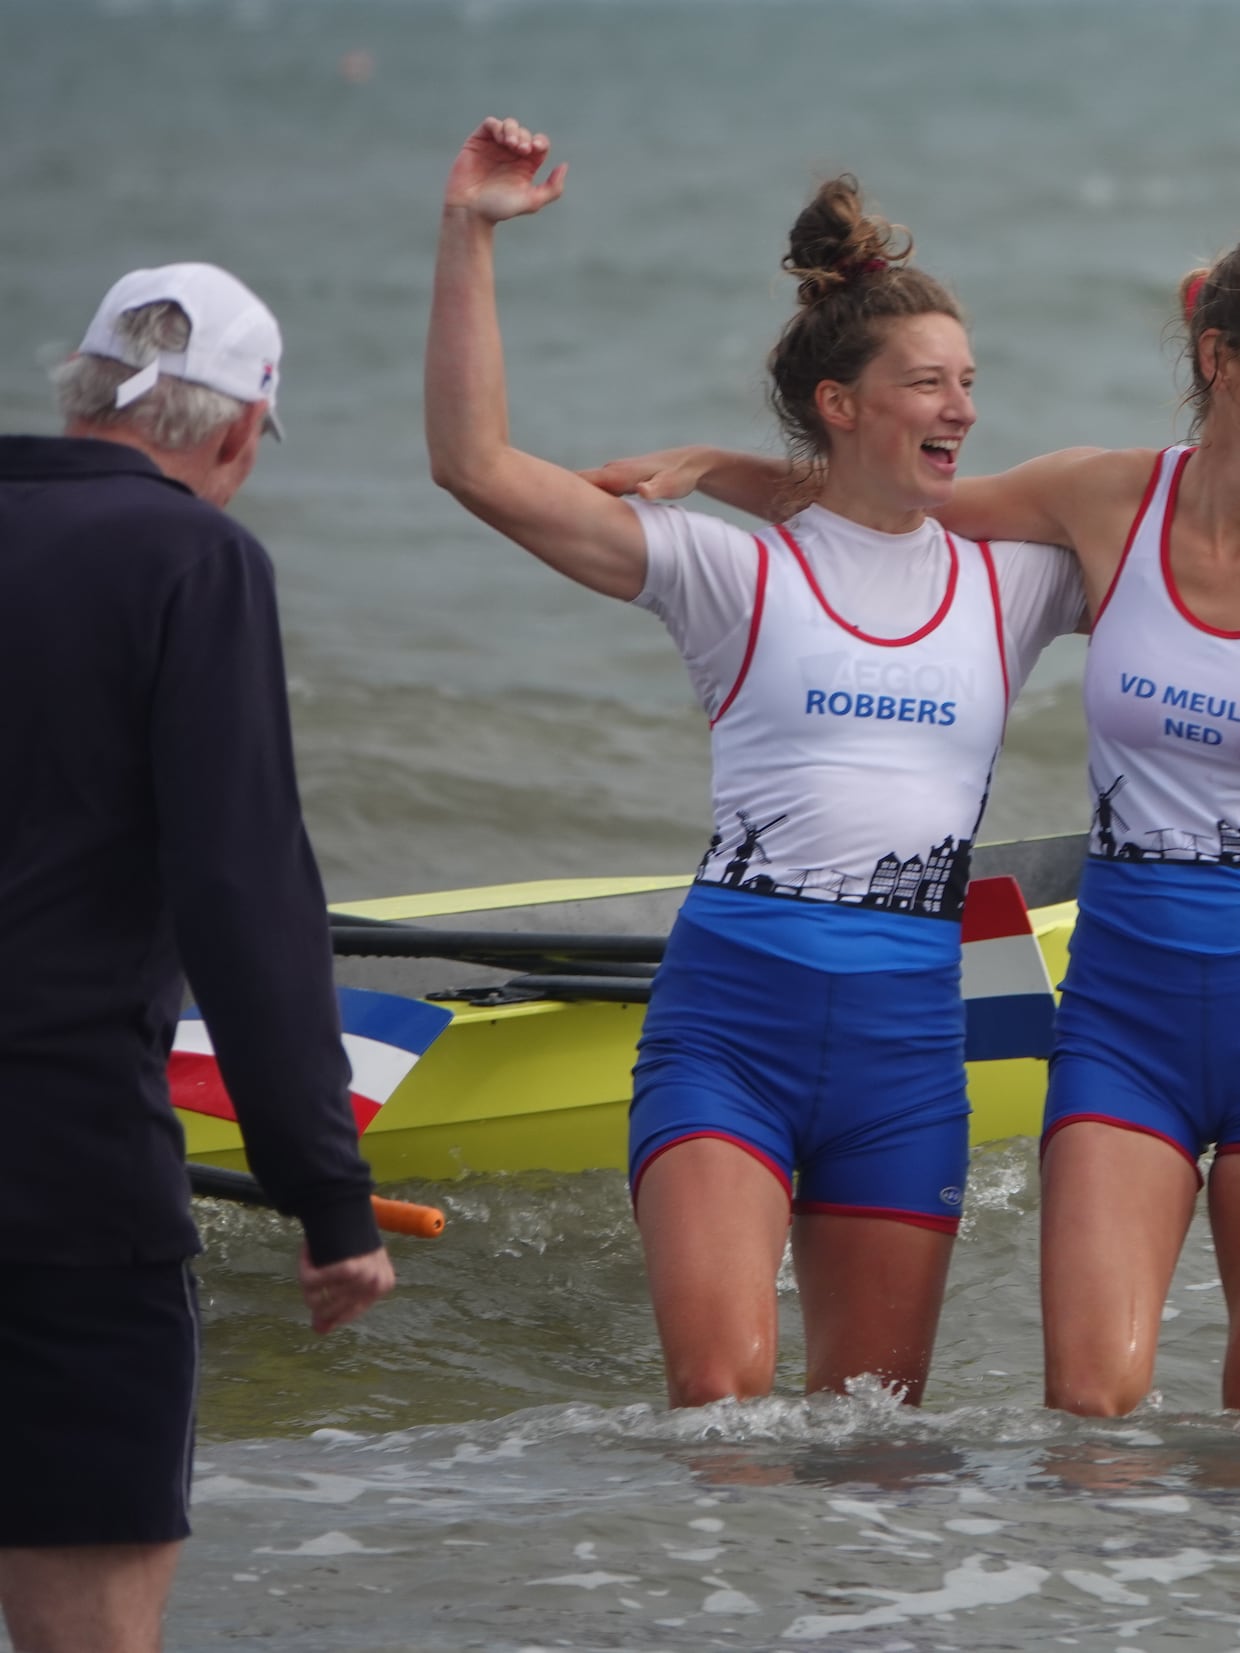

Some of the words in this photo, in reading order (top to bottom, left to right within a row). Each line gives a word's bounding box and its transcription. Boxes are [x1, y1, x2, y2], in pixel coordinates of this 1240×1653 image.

[1120, 672, 1157, 699] VD
[805, 689, 957, 726] ROBBERS
[1163, 717, 1224, 746] NED
